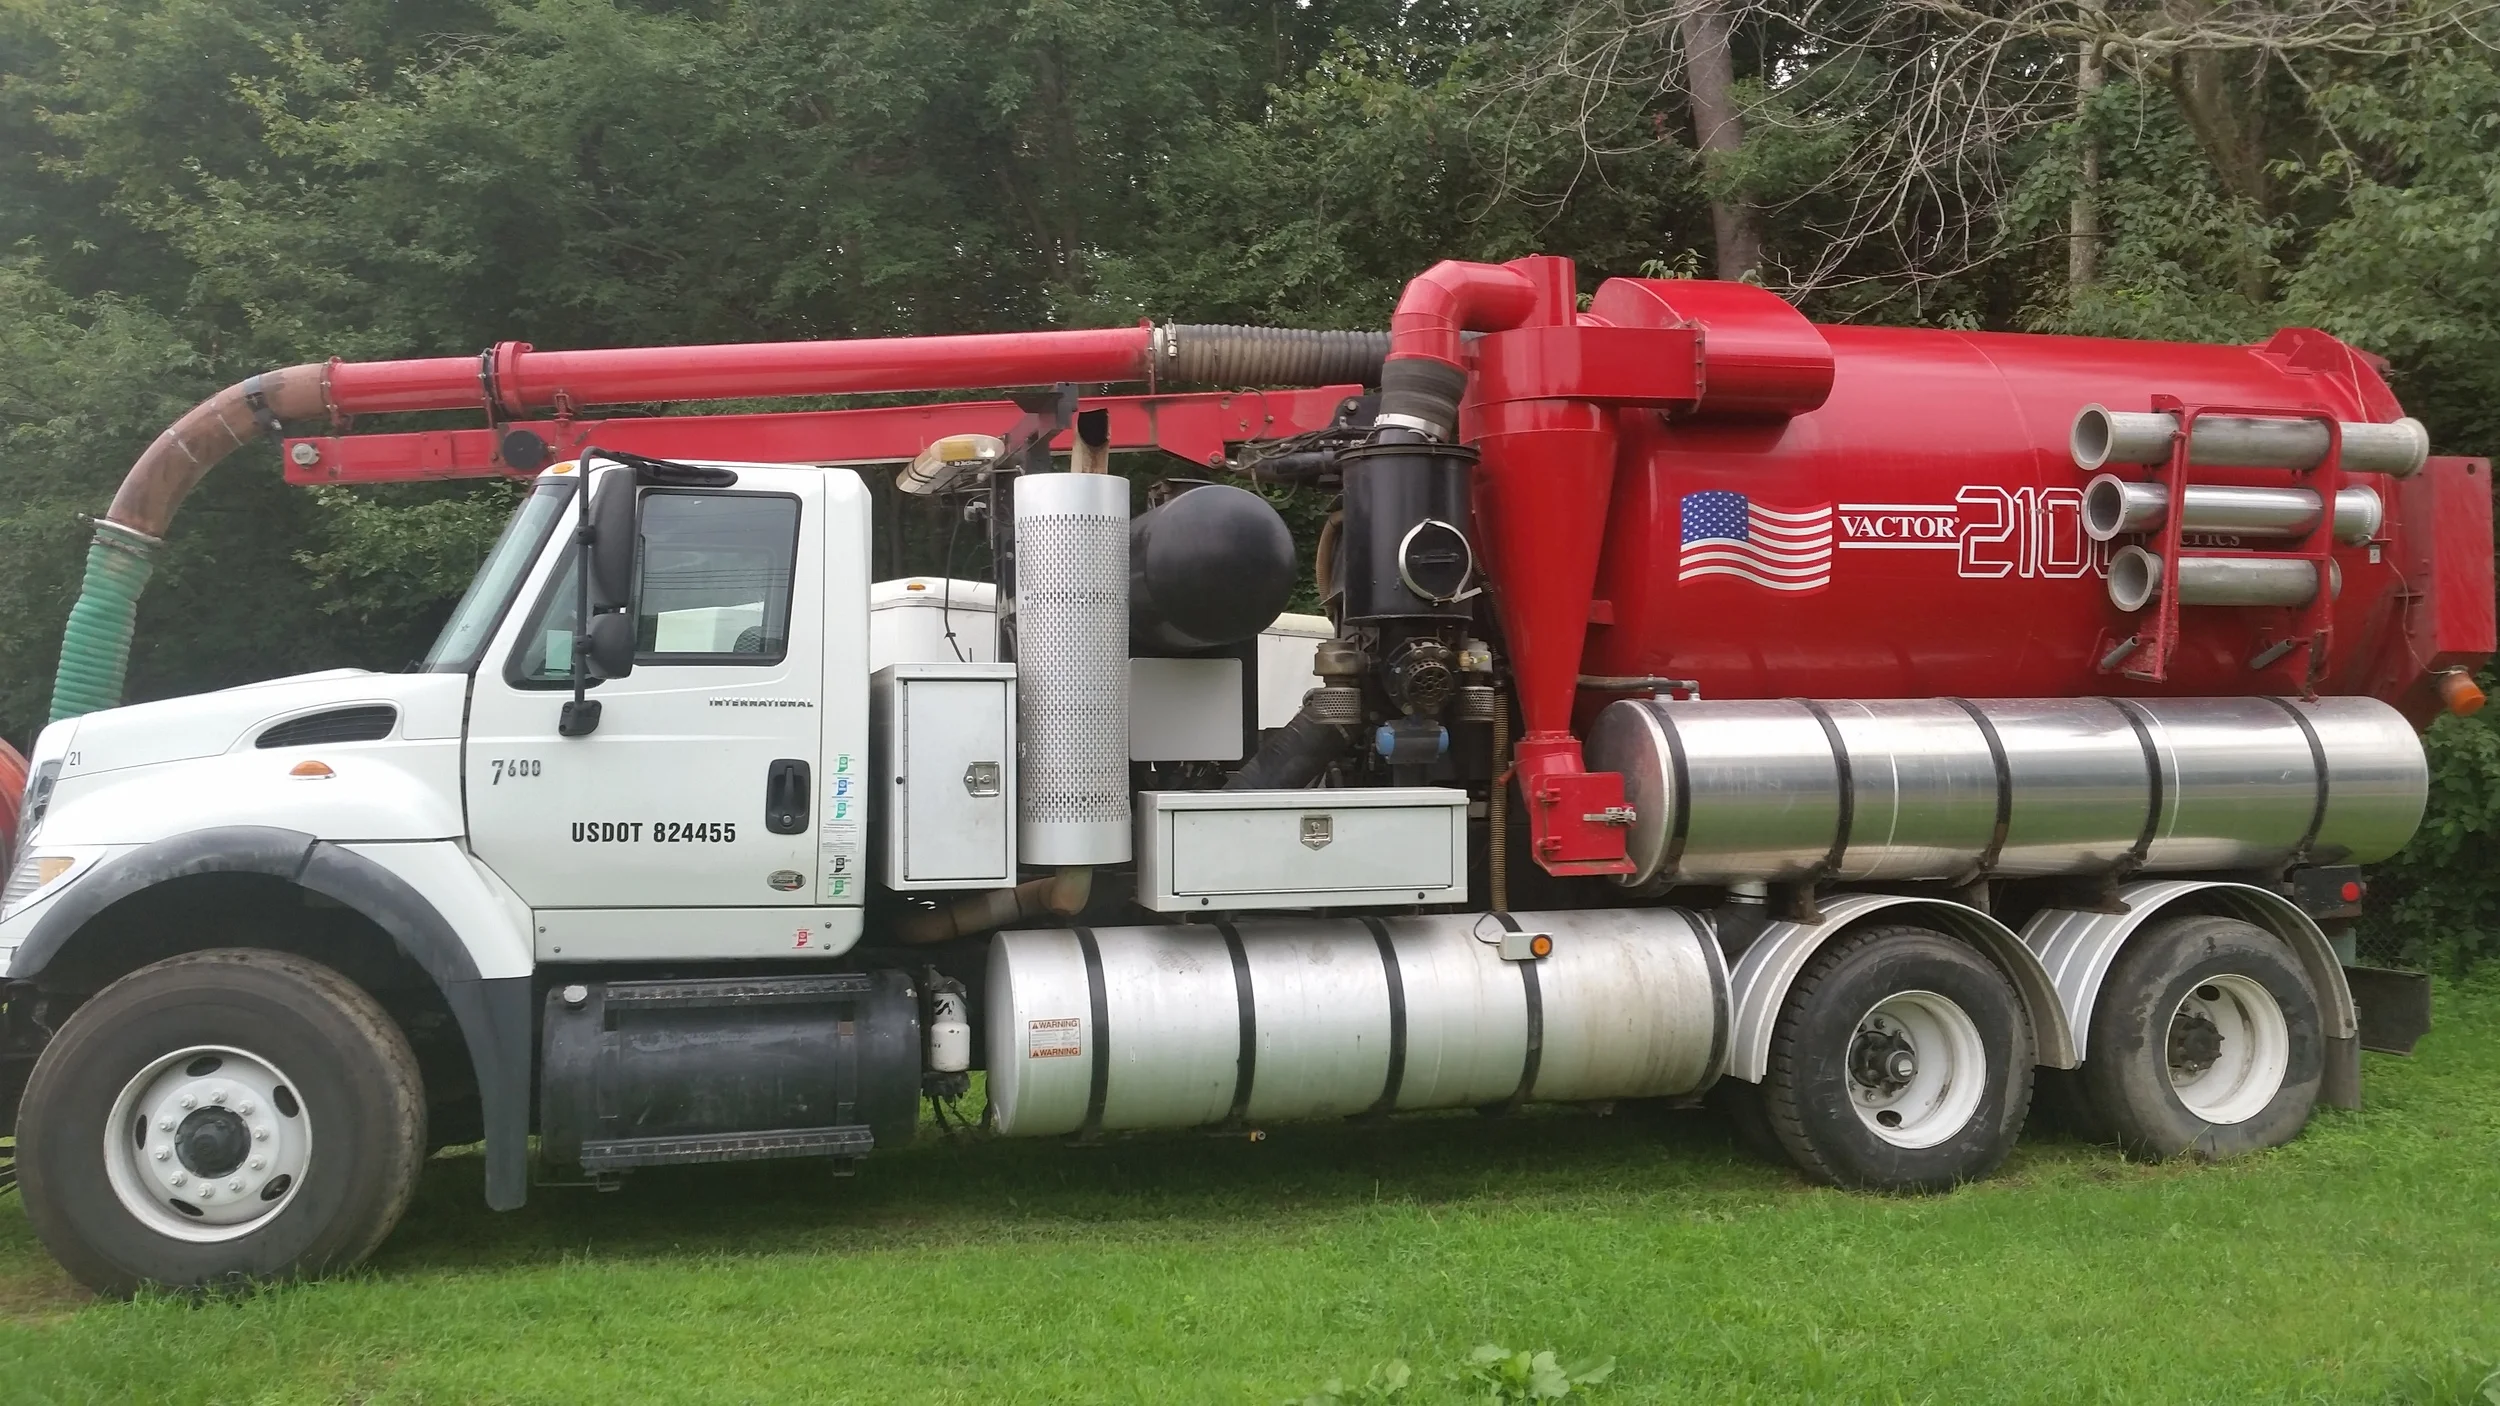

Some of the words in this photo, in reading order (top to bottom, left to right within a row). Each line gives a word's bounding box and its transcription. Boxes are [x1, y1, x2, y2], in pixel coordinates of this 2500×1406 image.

[1955, 485, 2147, 579] 210
[709, 697, 814, 708] INTERNATIONAL
[70, 751, 81, 766] 21
[492, 758, 541, 785] 7600
[571, 822, 643, 843] USDOT
[653, 822, 736, 843] 824455
[1039, 1020, 1078, 1029] WARNING
[1039, 1048, 1078, 1057] WARNING
